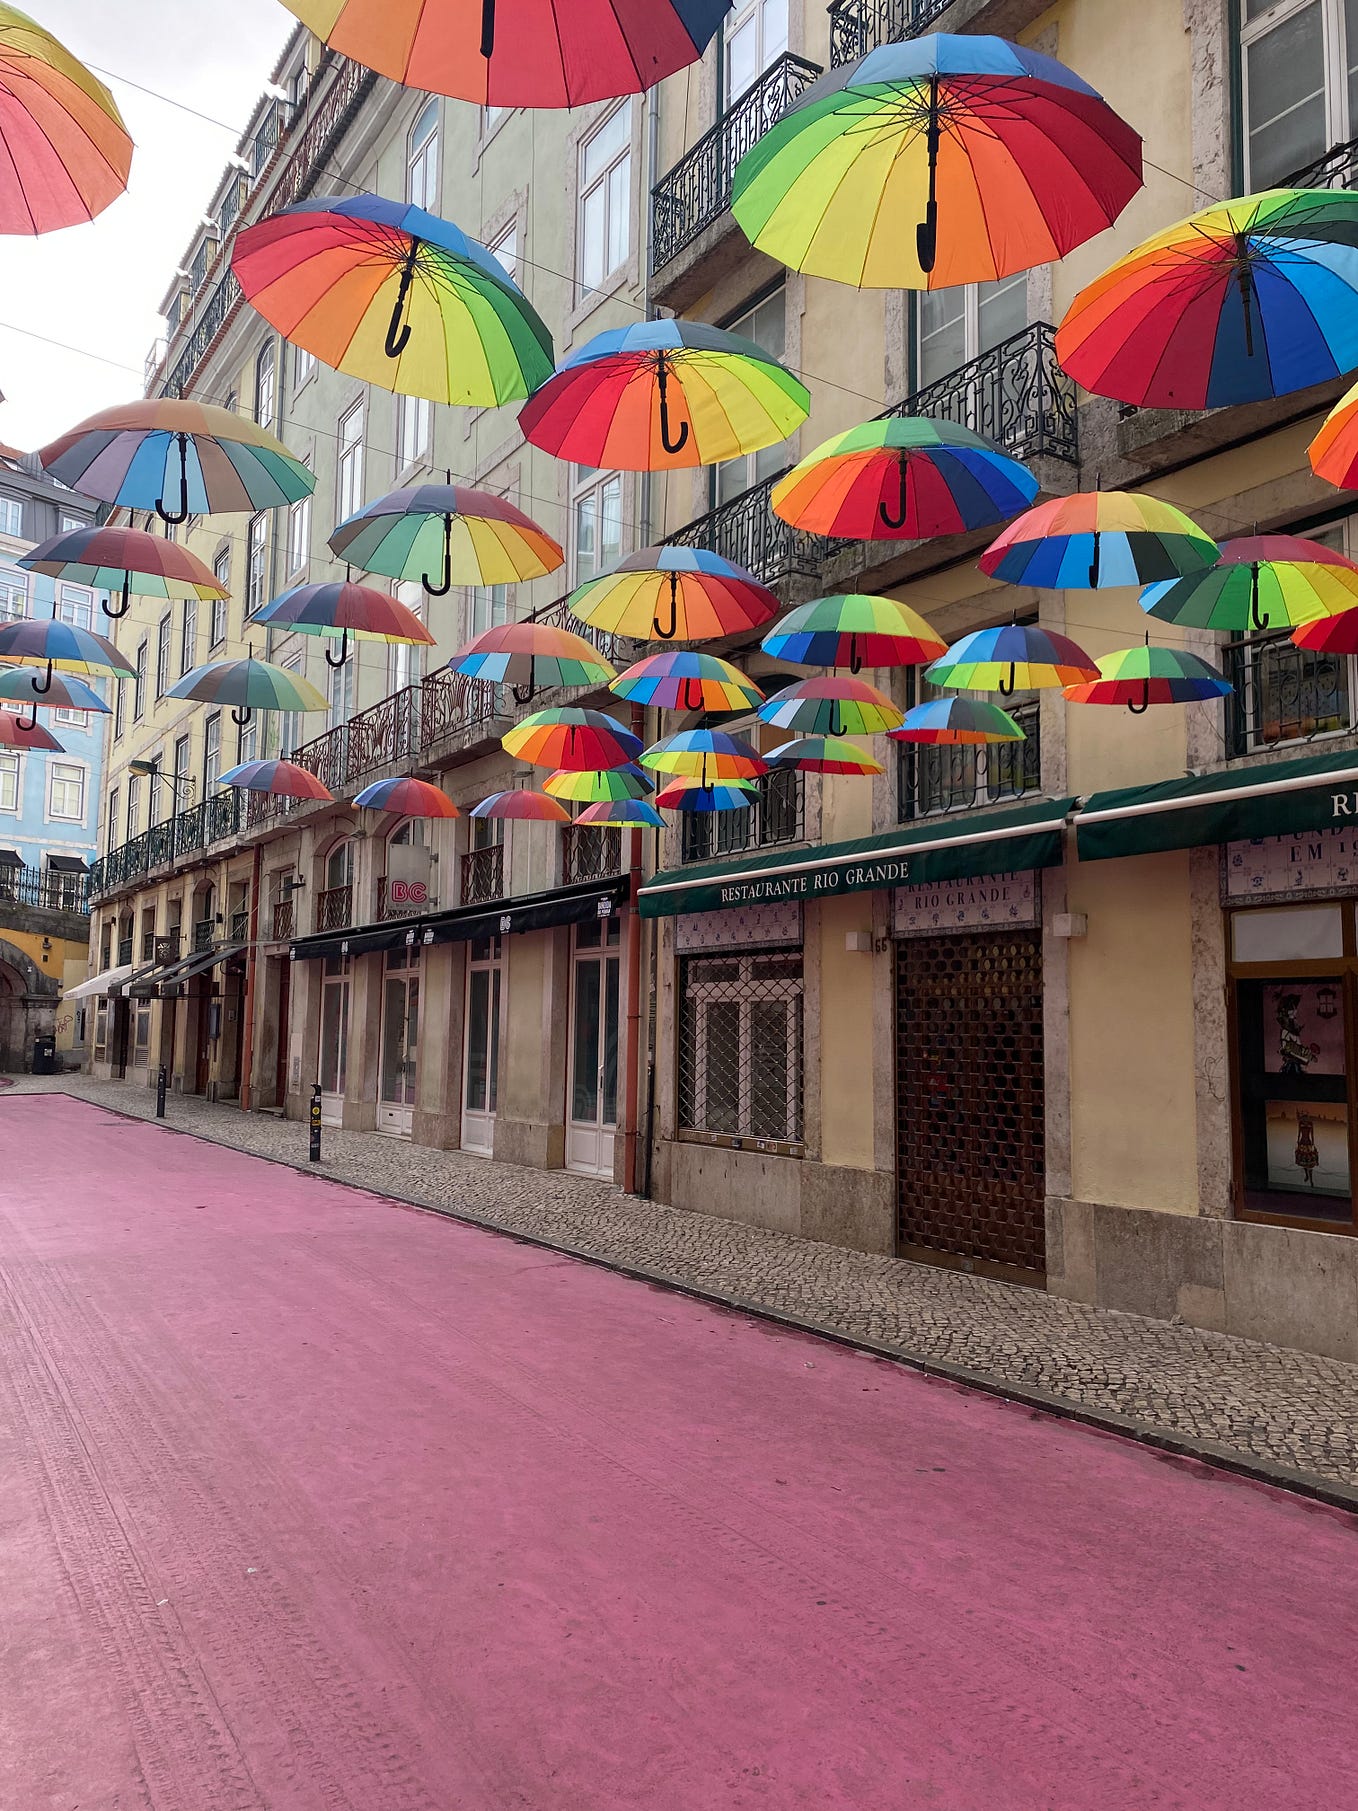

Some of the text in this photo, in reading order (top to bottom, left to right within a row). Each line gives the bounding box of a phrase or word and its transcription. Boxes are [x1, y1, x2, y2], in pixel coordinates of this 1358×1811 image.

[1290, 843, 1322, 862] EM
[392, 881, 427, 903] BC
[721, 862, 909, 902] RESTAURANTE RIO GRANDE
[915, 887, 1011, 909] RIO GRANDE
